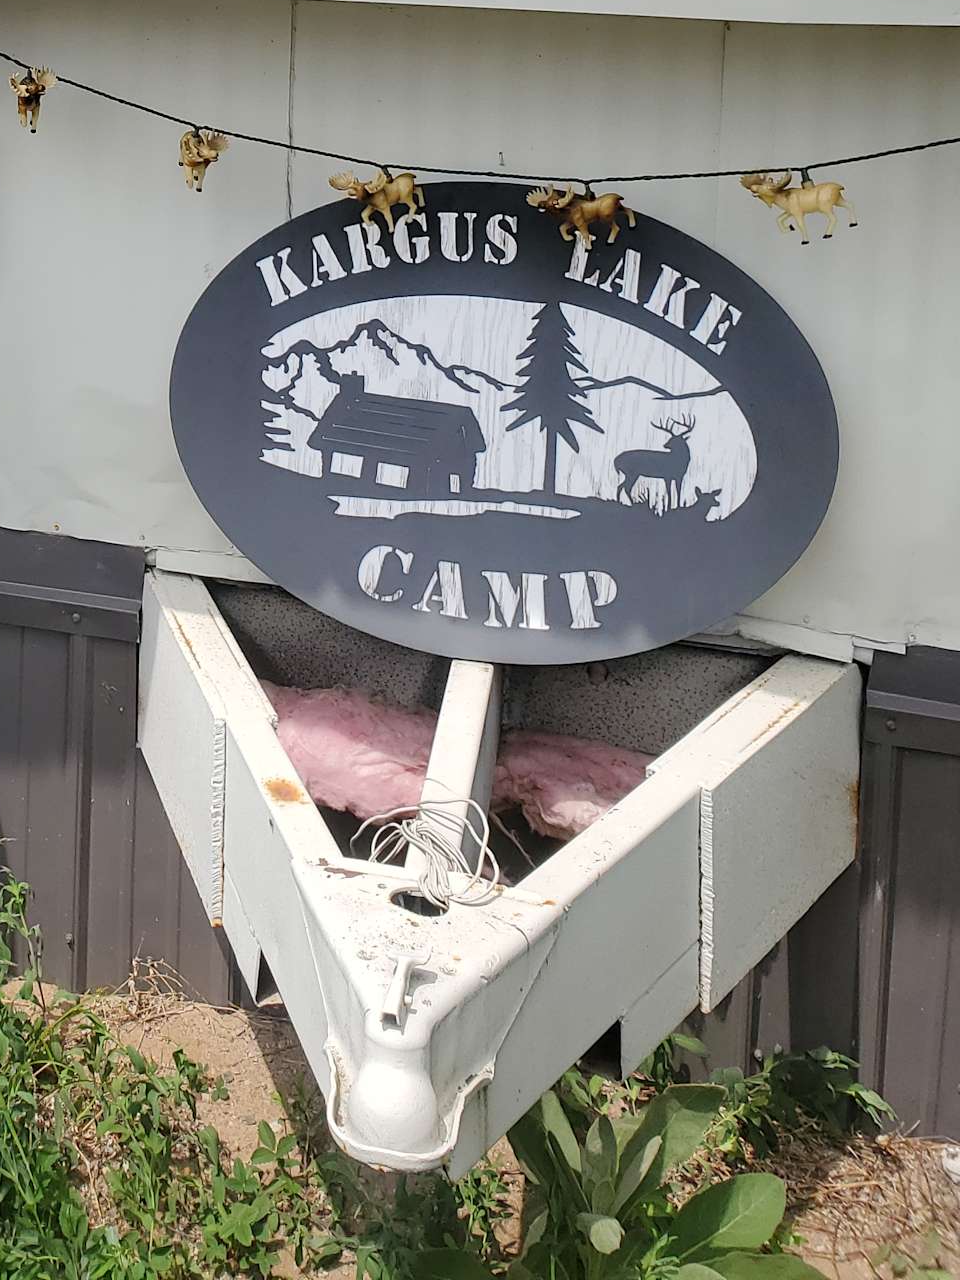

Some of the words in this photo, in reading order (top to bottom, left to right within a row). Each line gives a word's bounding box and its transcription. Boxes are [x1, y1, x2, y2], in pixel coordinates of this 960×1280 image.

[255, 211, 519, 307] KARGUS
[564, 230, 743, 356] LAKE
[357, 544, 618, 630] CAMP
